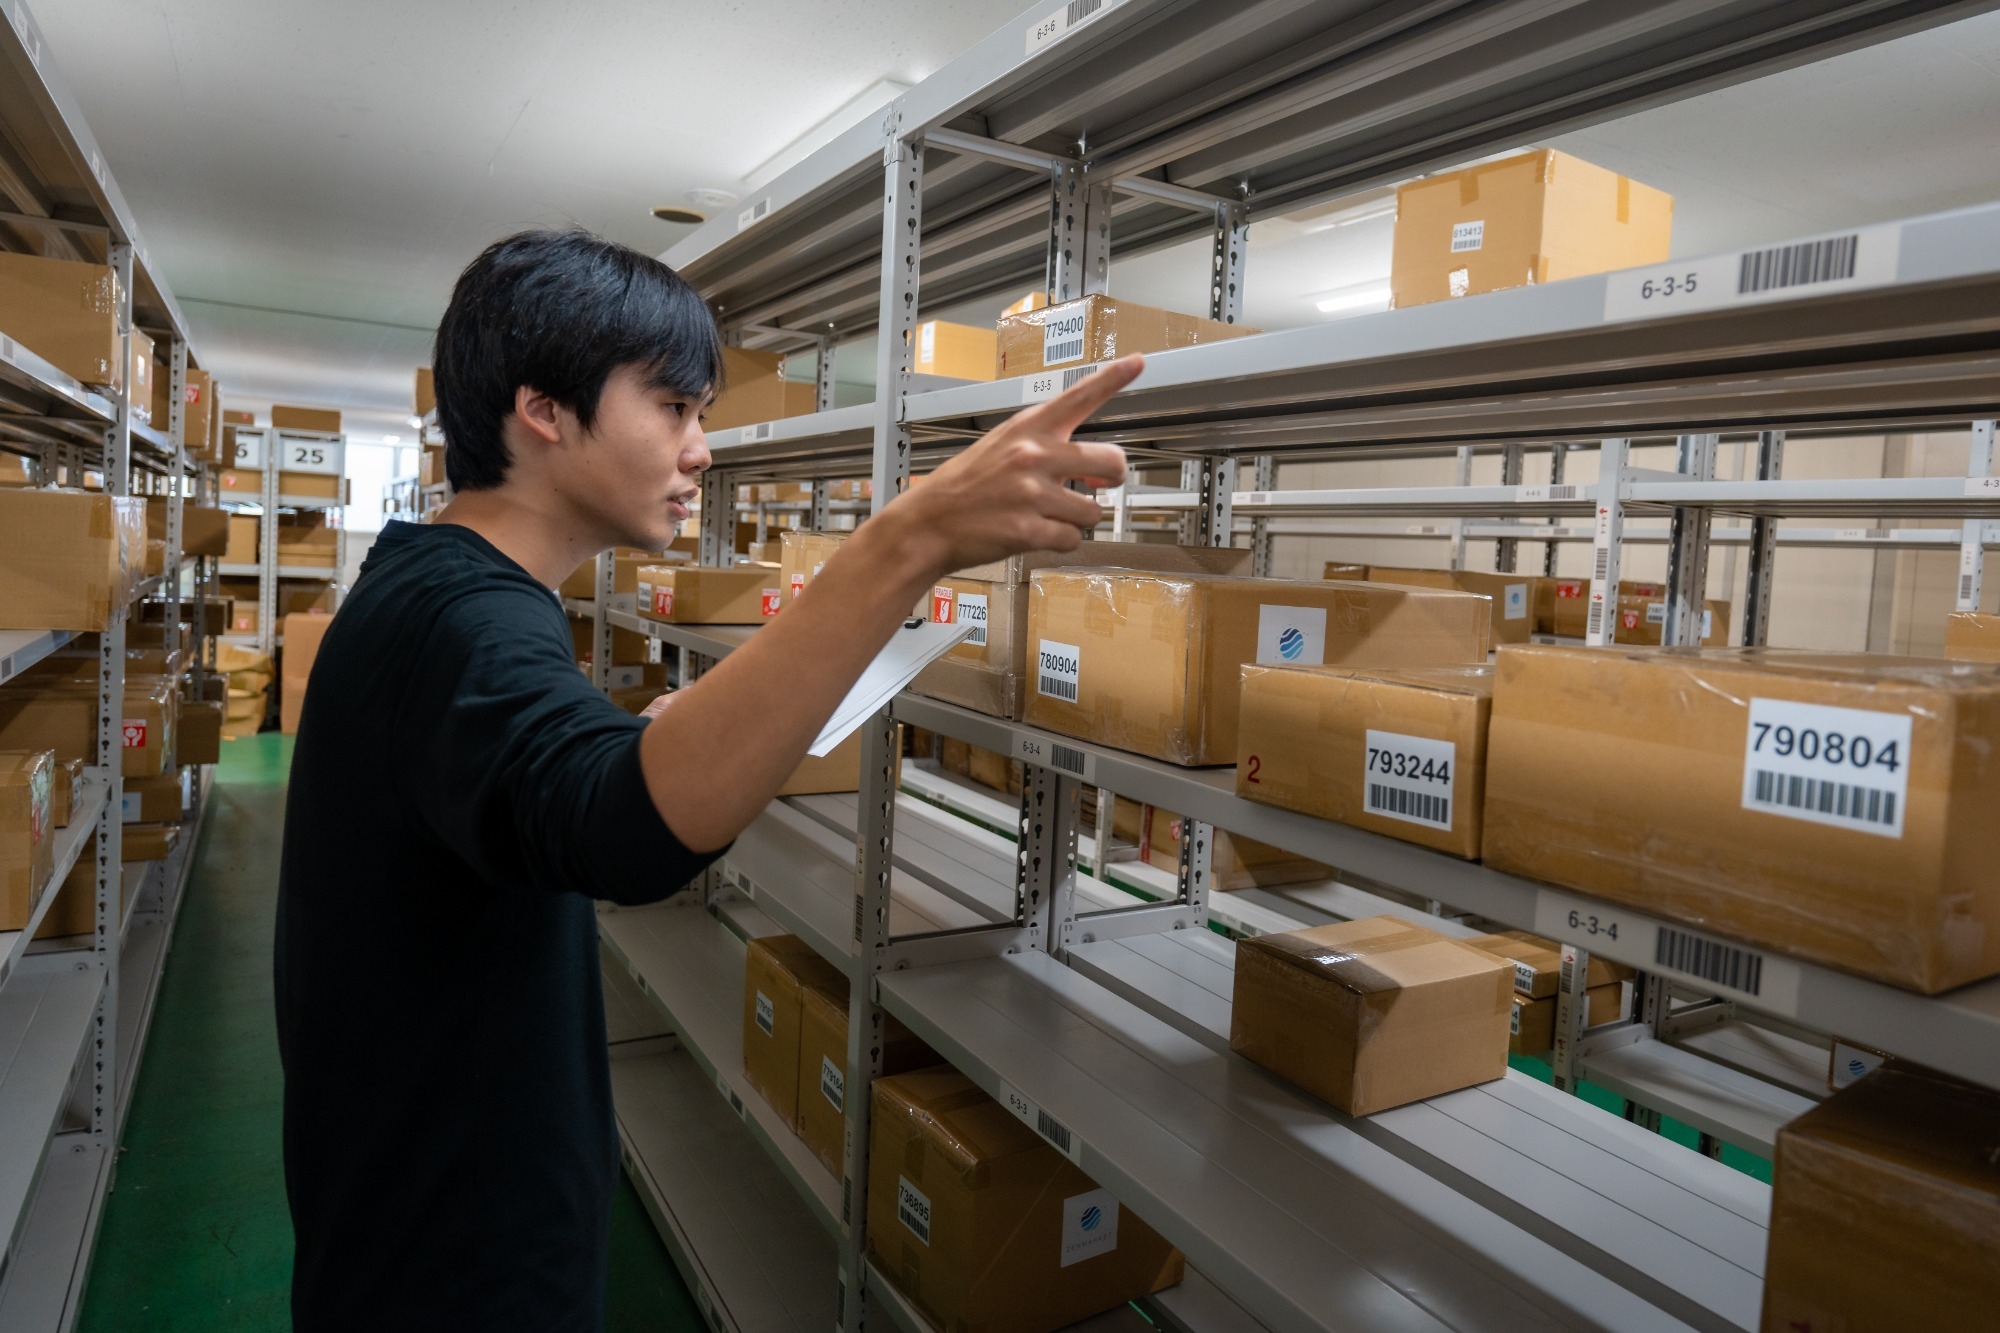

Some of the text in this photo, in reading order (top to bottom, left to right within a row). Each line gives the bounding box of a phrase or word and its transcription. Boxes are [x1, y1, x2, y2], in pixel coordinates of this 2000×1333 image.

[1037, 20, 1056, 40] 6-3-6
[1641, 273, 1698, 299] 6-3-5
[1045, 316, 1084, 339] 779400
[1033, 380, 1052, 393] 6-3-5
[295, 447, 324, 465] 25
[935, 587, 953, 599] FRAGILE
[958, 603, 988, 621] 777226
[1040, 652, 1077, 675] 780904
[1022, 740, 1041, 756] 6-3-4
[1752, 722, 1900, 772] 790804
[1248, 754, 1261, 784] 2
[1368, 747, 1449, 785] 793244
[1567, 909, 1618, 941] 6-3-4
[823, 1063, 843, 1093] 779164
[1009, 1093, 1027, 1115] 6-3-3
[899, 1185, 930, 1222] 736895
[1065, 1231, 1114, 1253] ZENMARKET
